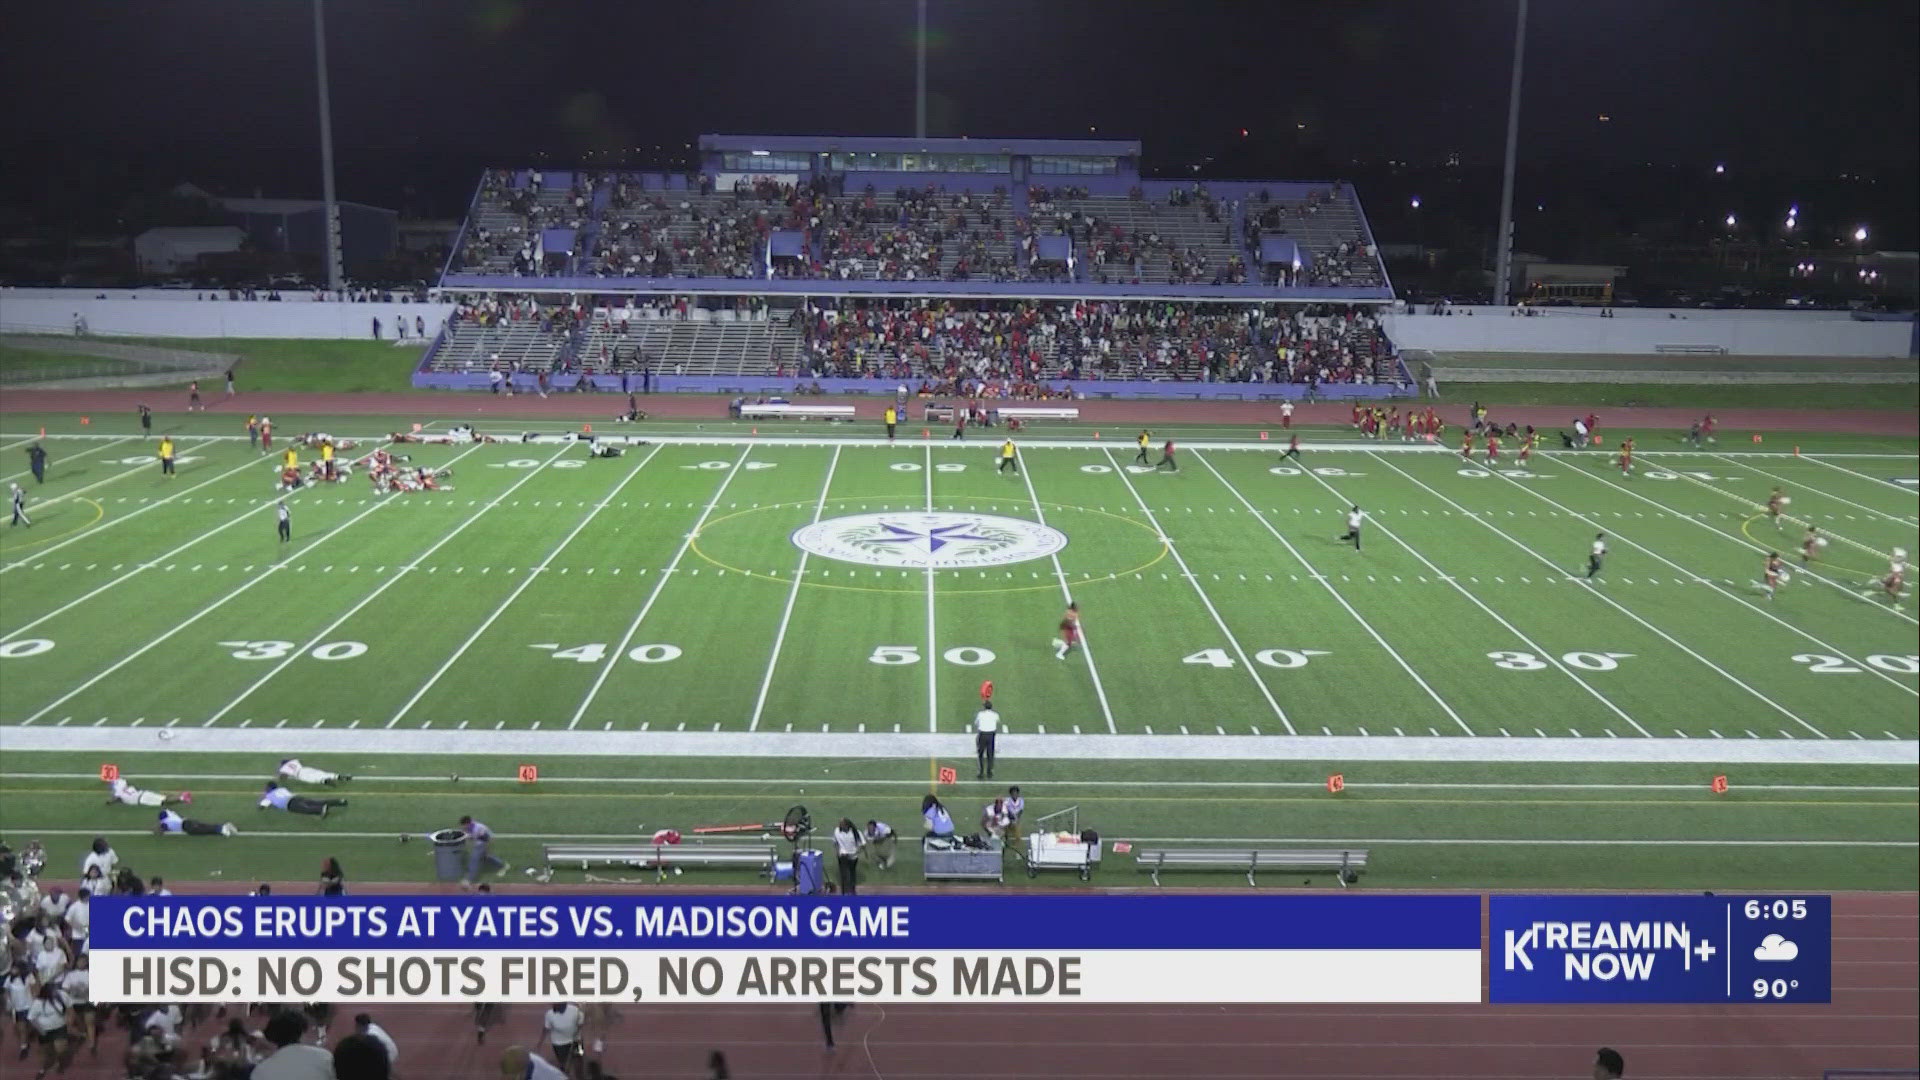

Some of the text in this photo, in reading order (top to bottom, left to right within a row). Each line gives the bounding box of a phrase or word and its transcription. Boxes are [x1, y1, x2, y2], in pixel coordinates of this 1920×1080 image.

[231, 640, 369, 660] 30
[552, 642, 683, 663] 40
[867, 646, 996, 666] 50
[1182, 647, 1309, 669] 40
[1486, 650, 1620, 671] 30
[1791, 653, 1919, 674] 20
